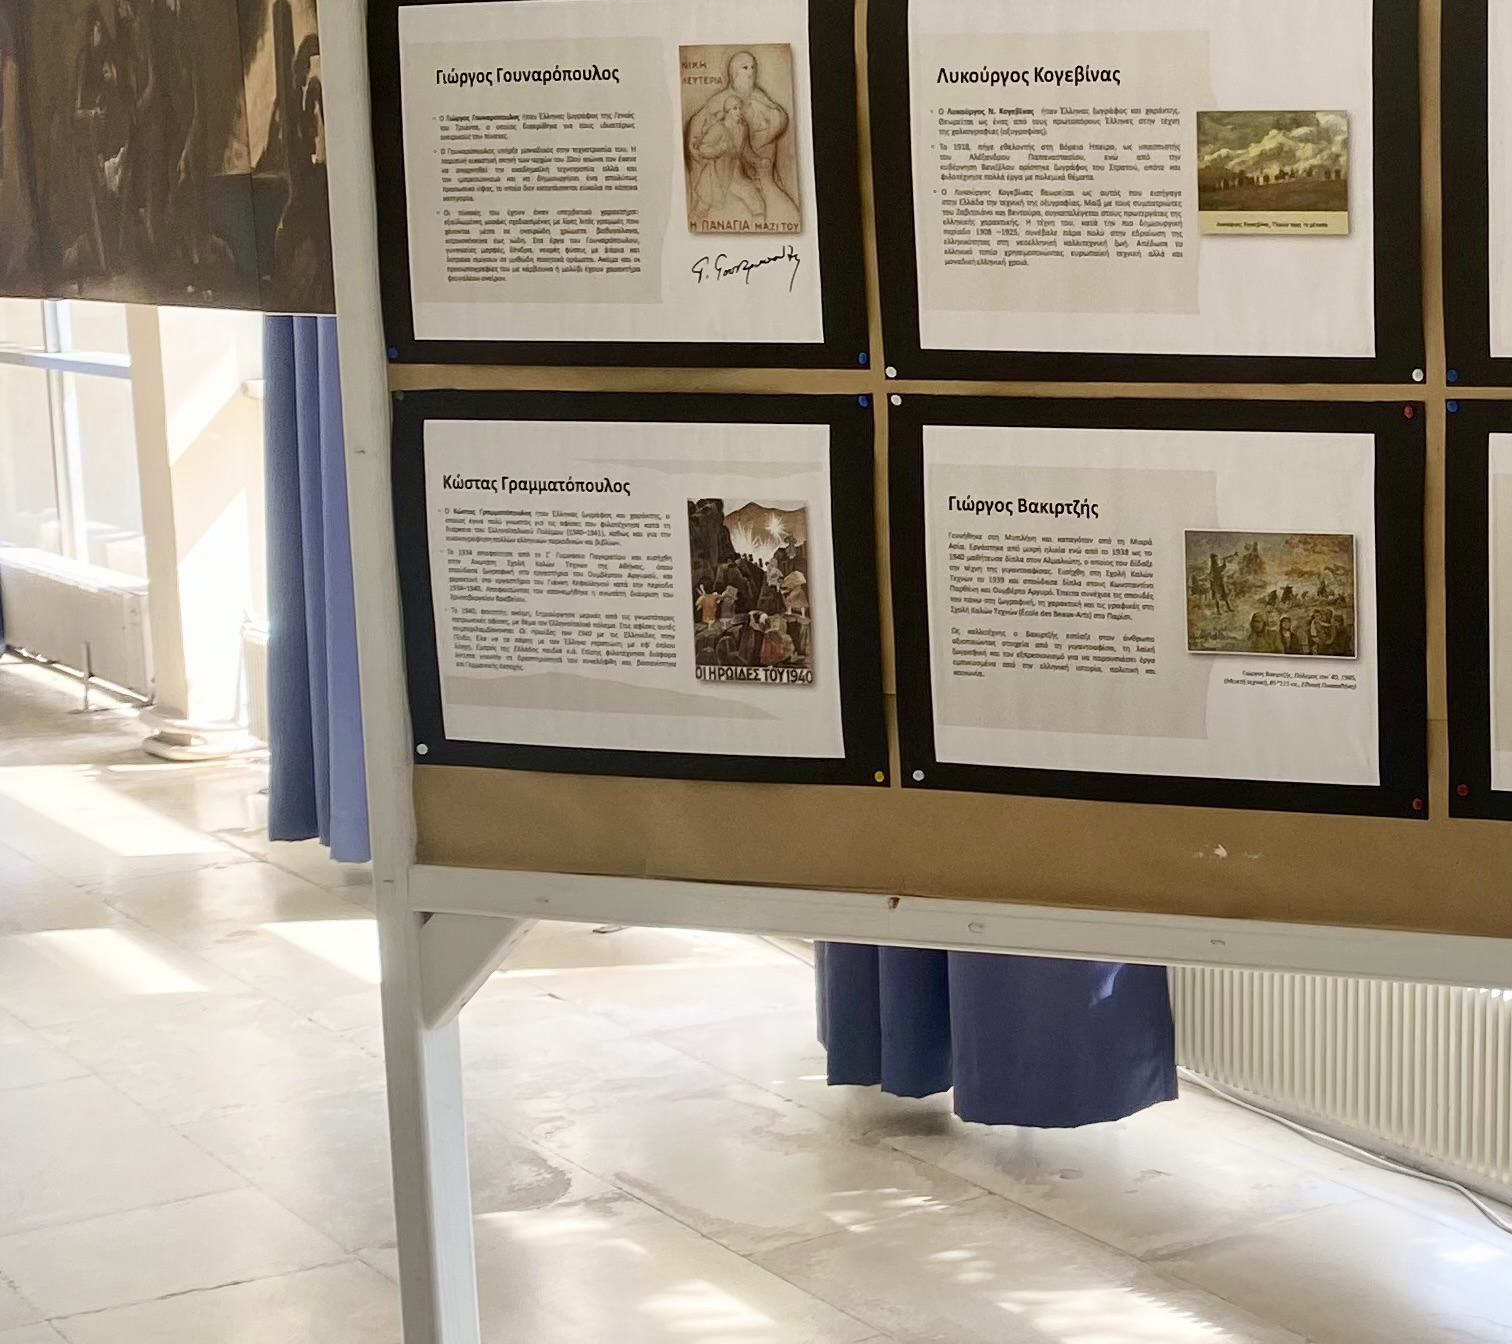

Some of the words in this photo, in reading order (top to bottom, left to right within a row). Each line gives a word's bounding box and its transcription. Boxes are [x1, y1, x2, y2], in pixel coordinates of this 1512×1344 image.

[436, 66, 493, 87] Γιώργος
[496, 64, 620, 86] Γουναρόπουλος
[936, 65, 1029, 87] Λυκούργος
[1033, 64, 1120, 86] Κογεβίνας
[690, 220, 698, 230] Η
[702, 219, 750, 231] ΠΑΝΑΓΙΑ
[781, 222, 799, 231] ΤΟΥ
[442, 473, 498, 493] Κώστας
[501, 475, 630, 496] Γραμματόπουλος
[948, 494, 1014, 517] Γιώργος
[1017, 496, 1100, 520] Βακιρτζής
[694, 664, 707, 685] ΟΙ
[761, 665, 785, 685] ΤΟΥ
[785, 665, 816, 685] 1940
